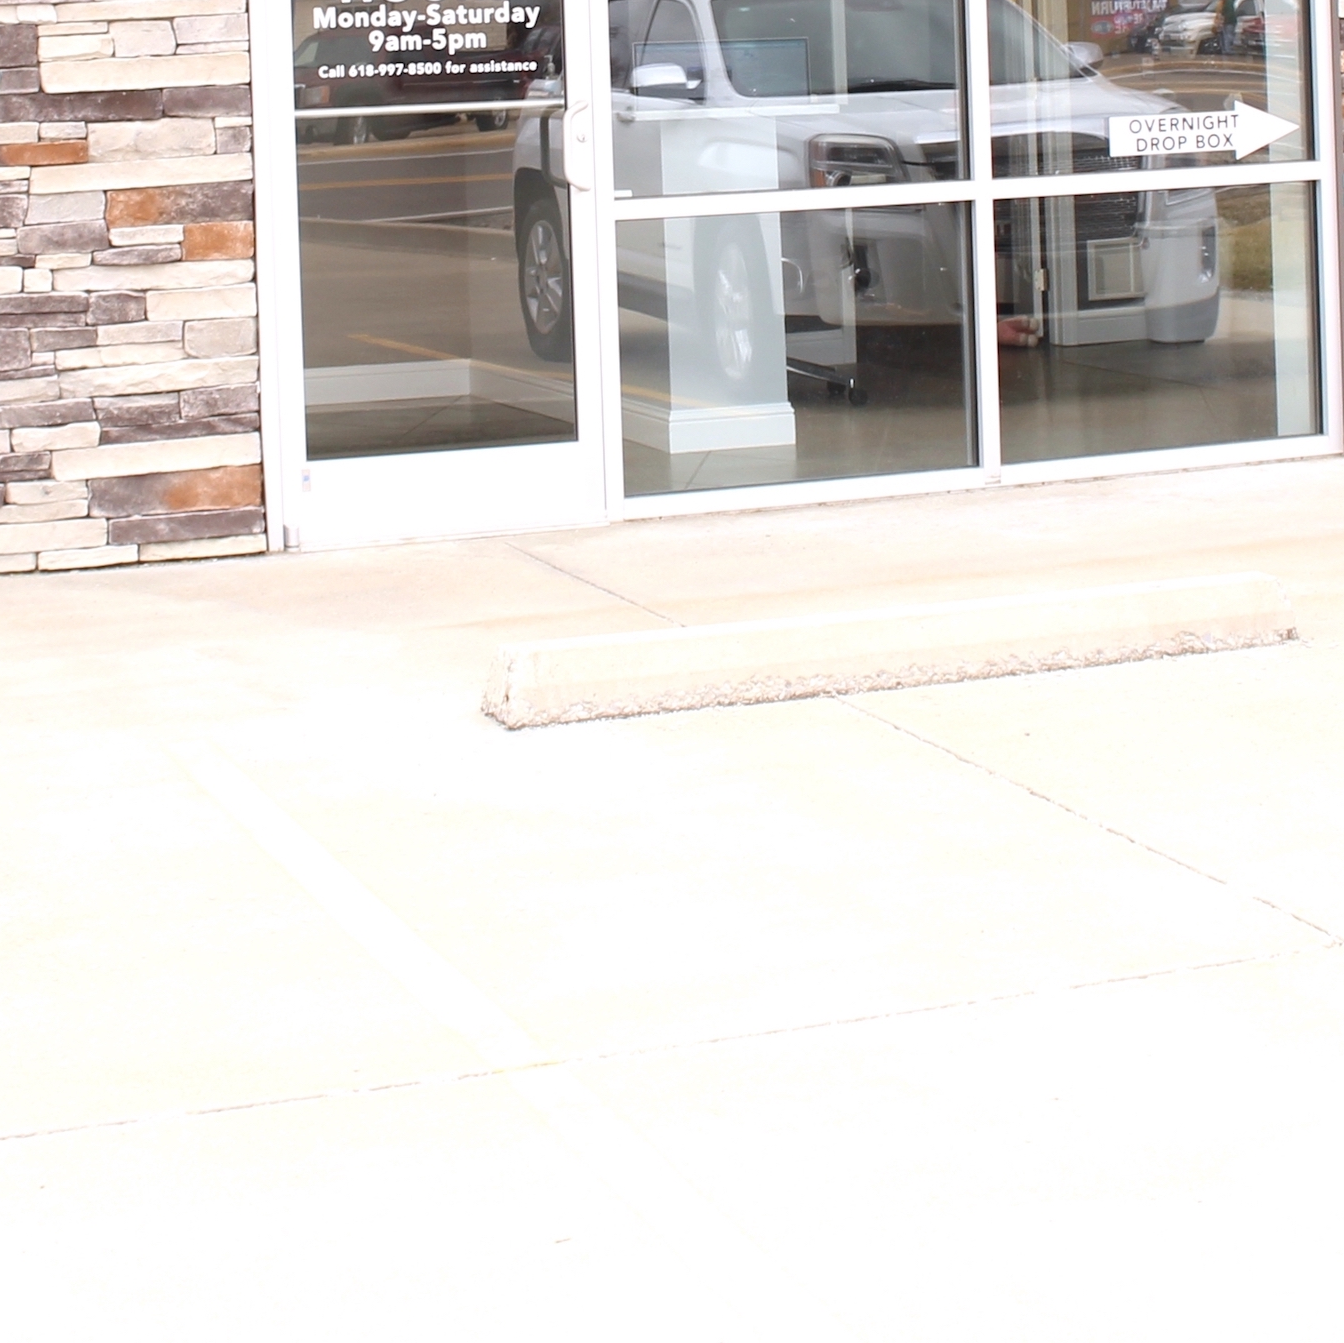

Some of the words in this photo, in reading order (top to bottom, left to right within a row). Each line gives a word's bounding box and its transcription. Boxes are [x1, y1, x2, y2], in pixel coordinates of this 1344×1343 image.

[313, 1, 540, 31] Monday-Saturday
[368, 28, 487, 55] 9am-5pm
[318, 65, 345, 79] Call
[348, 61, 442, 77] 618-997-8500
[445, 60, 466, 74] for
[469, 59, 538, 73] assistance
[1129, 114, 1239, 134] OVERNIGHT
[1136, 136, 1187, 152] DROP
[1196, 133, 1233, 149] BOX
